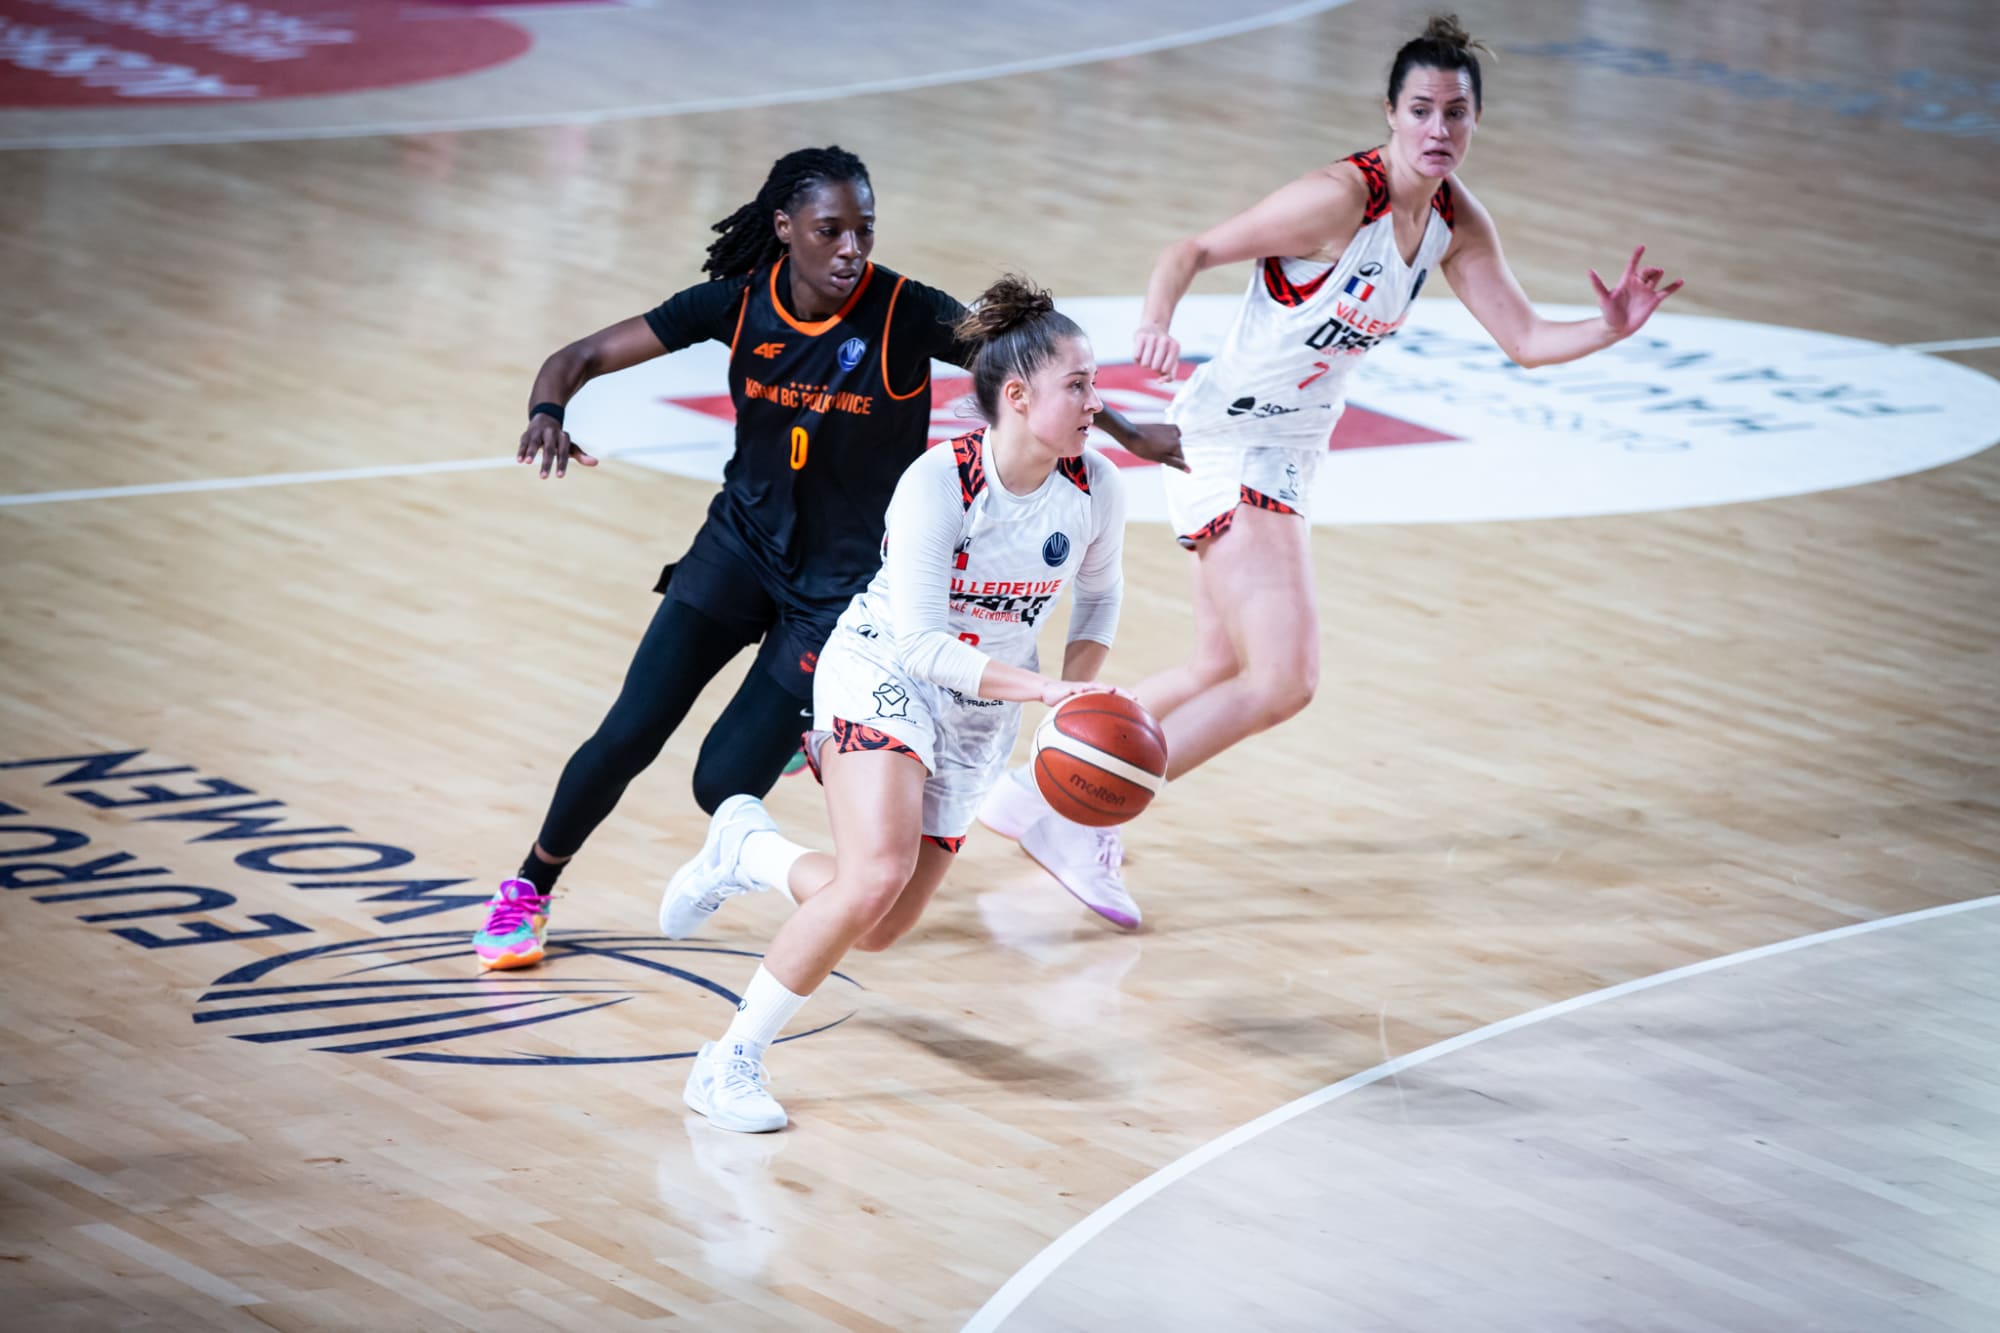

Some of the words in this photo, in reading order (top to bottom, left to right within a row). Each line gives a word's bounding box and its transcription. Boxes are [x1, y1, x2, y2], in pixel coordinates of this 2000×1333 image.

[752, 342, 786, 359] 4F
[1297, 361, 1330, 390] 7
[781, 388, 798, 408] BC
[801, 391, 873, 415] POLKWICE
[790, 426, 809, 470] 0
[1070, 774, 1126, 806] molten
[0, 748, 494, 924] WOMEN
[0, 803, 315, 949] EURO
